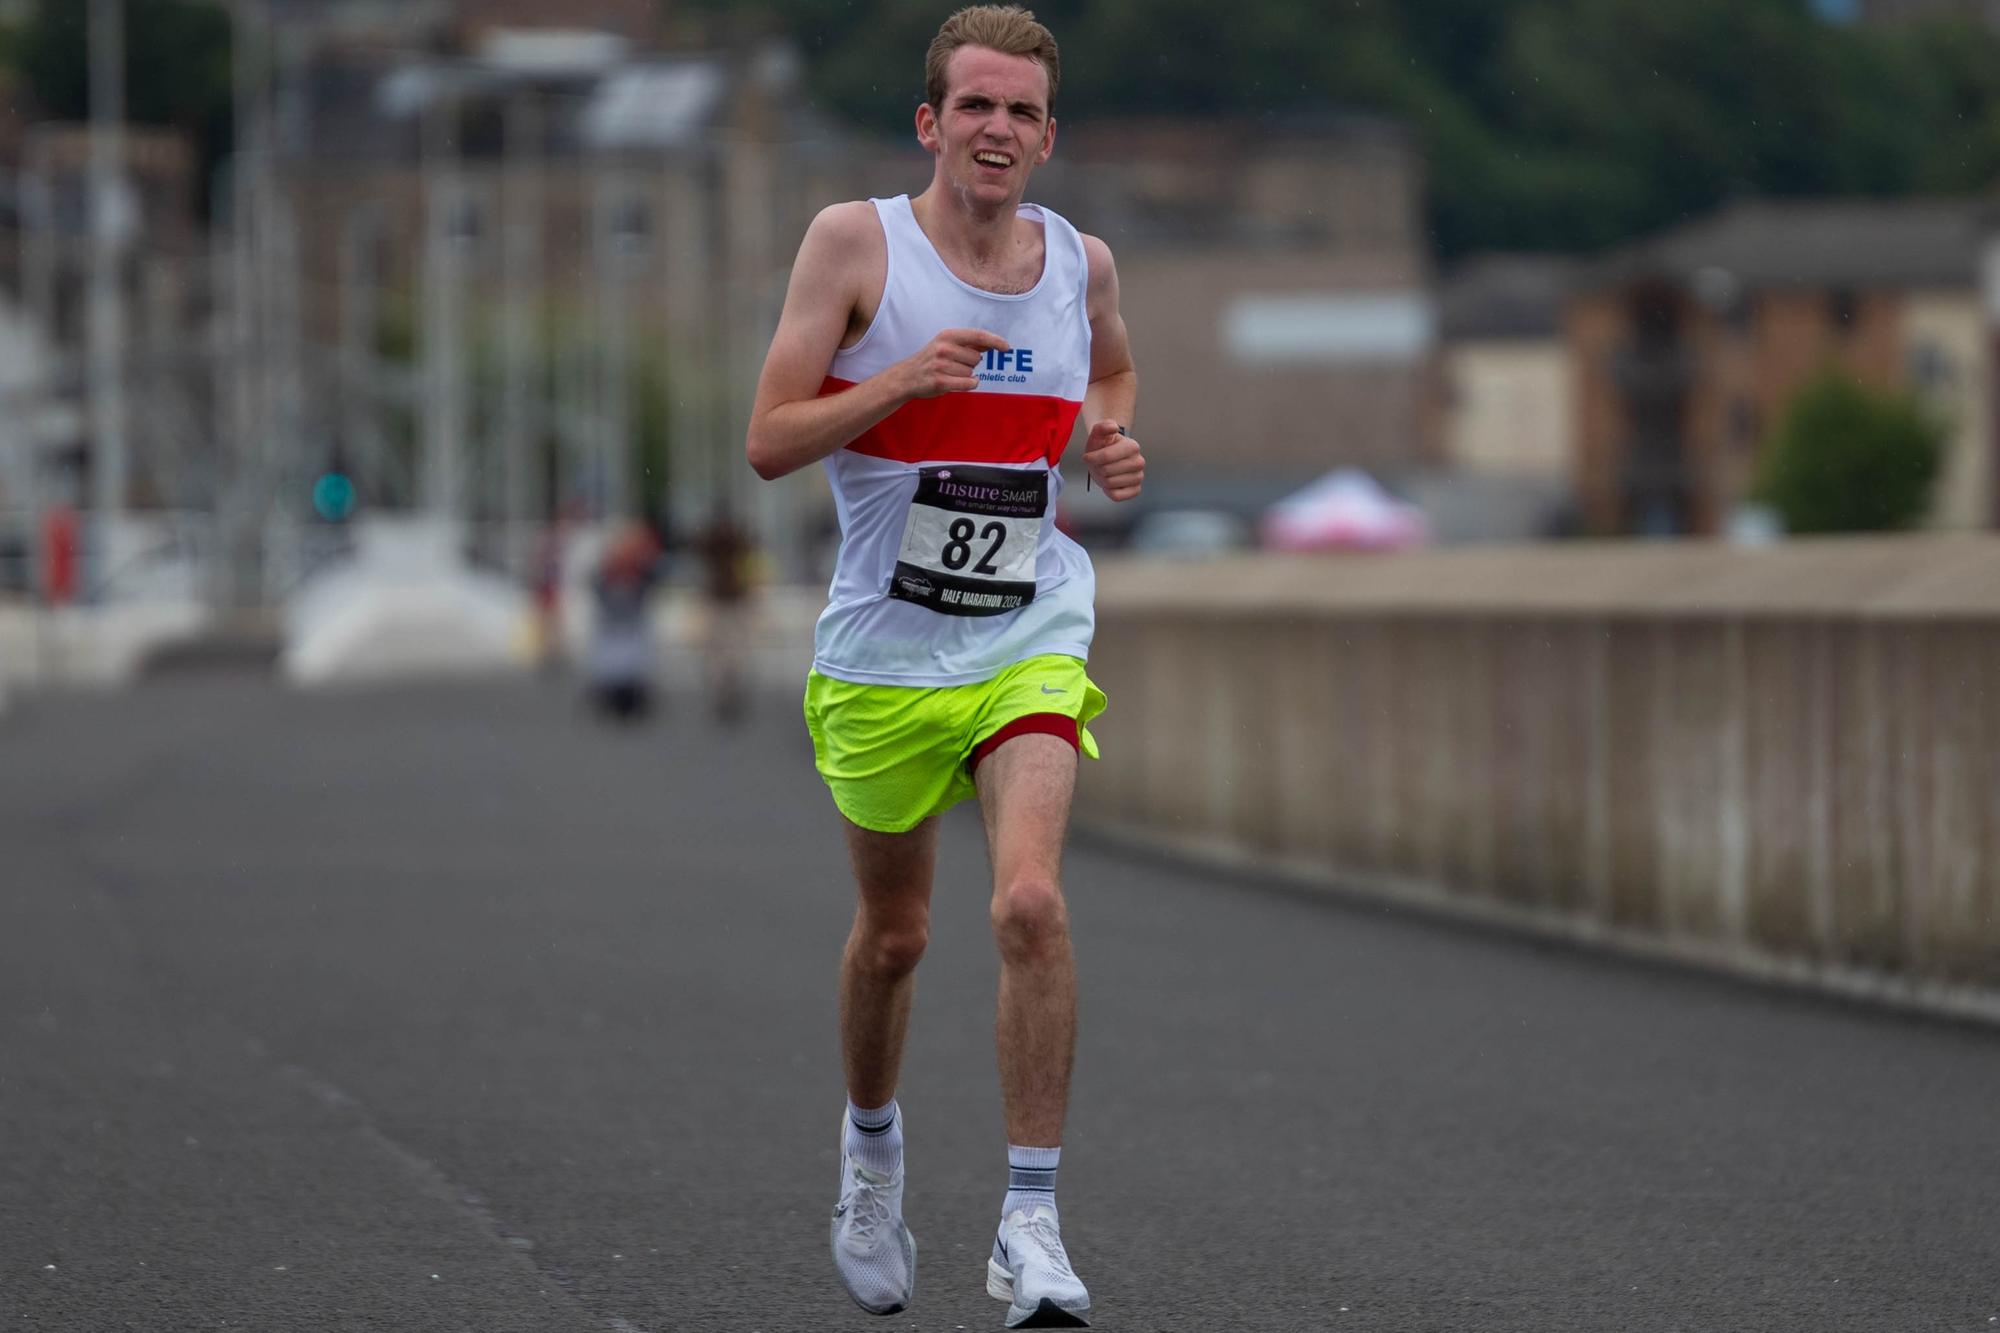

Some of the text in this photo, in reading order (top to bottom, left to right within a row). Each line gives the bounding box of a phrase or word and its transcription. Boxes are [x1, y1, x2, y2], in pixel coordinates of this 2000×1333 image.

[980, 348, 1033, 372] IFE
[976, 373, 1026, 383] thletic club
[968, 501, 997, 511] smarter
[941, 517, 1007, 575] 82
[941, 588, 962, 604] HALF
[961, 591, 1004, 608] MARATHON
[1002, 595, 1022, 608] 2024
